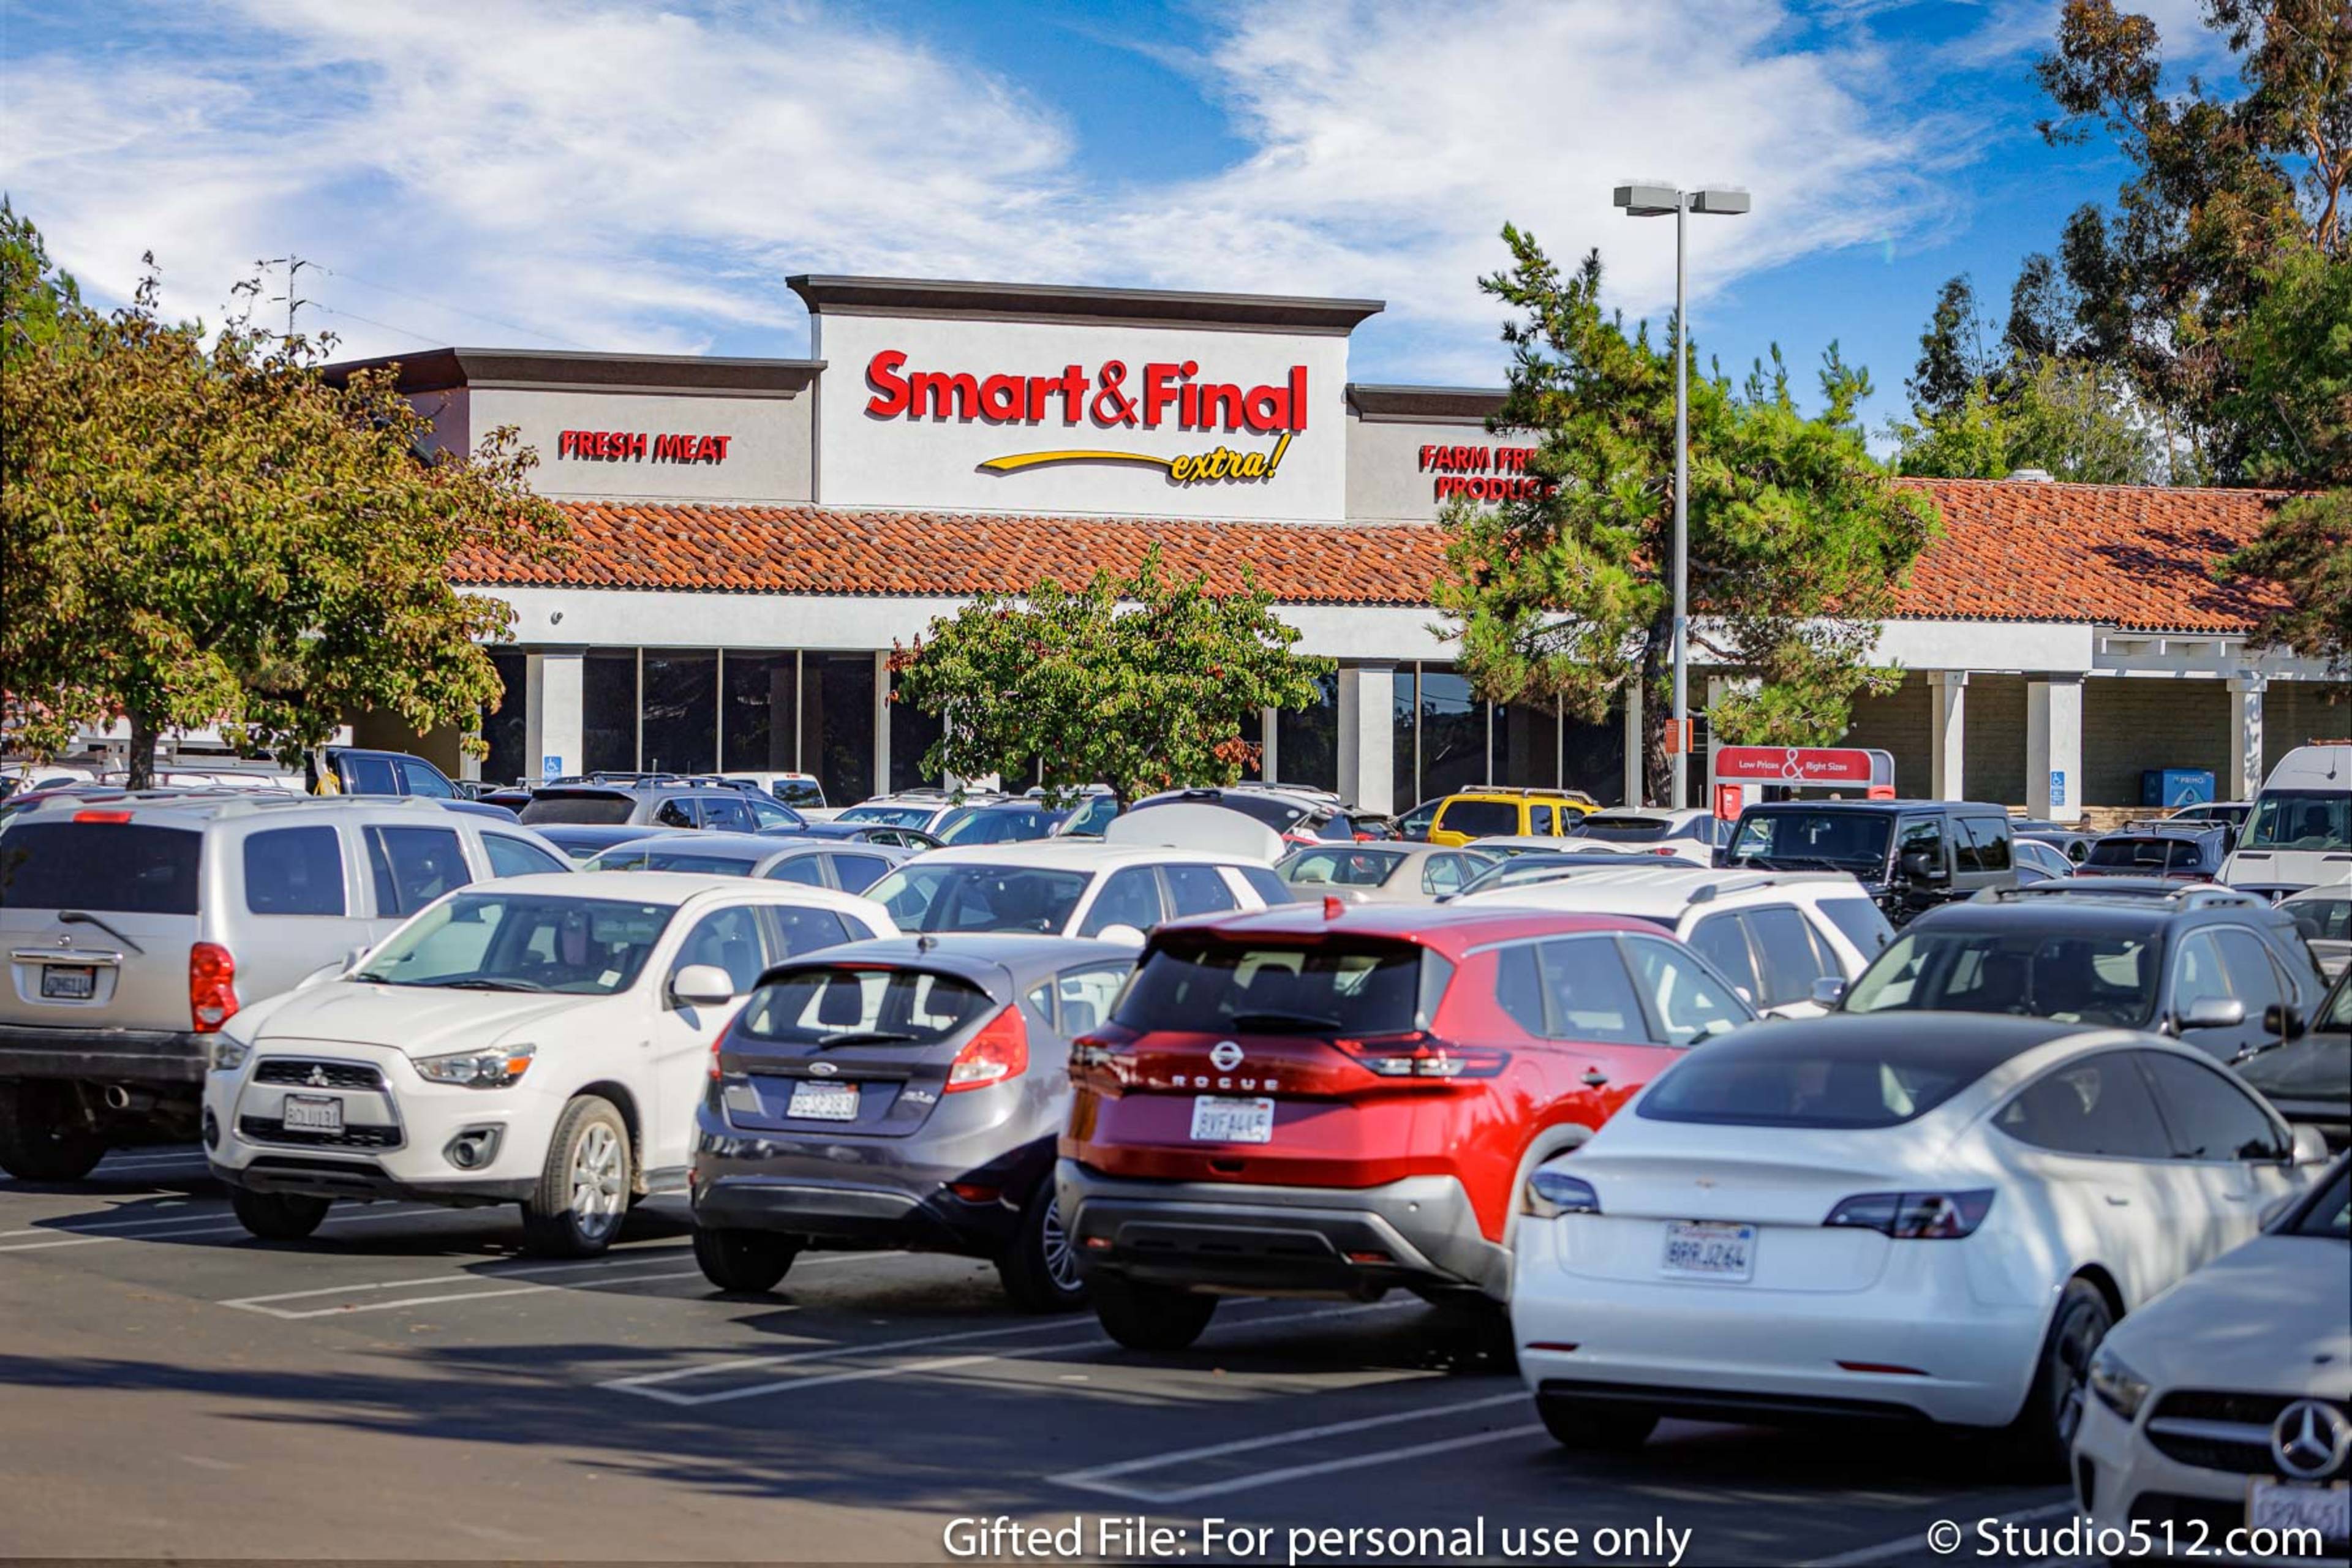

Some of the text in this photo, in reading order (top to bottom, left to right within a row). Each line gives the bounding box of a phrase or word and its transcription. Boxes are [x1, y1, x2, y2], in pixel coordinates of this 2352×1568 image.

[561, 431, 733, 460] FRESH MEAT
[1170, 432, 1291, 483] extra!
[1422, 445, 1491, 469] FARM
[1739, 760, 1755, 769] Low
